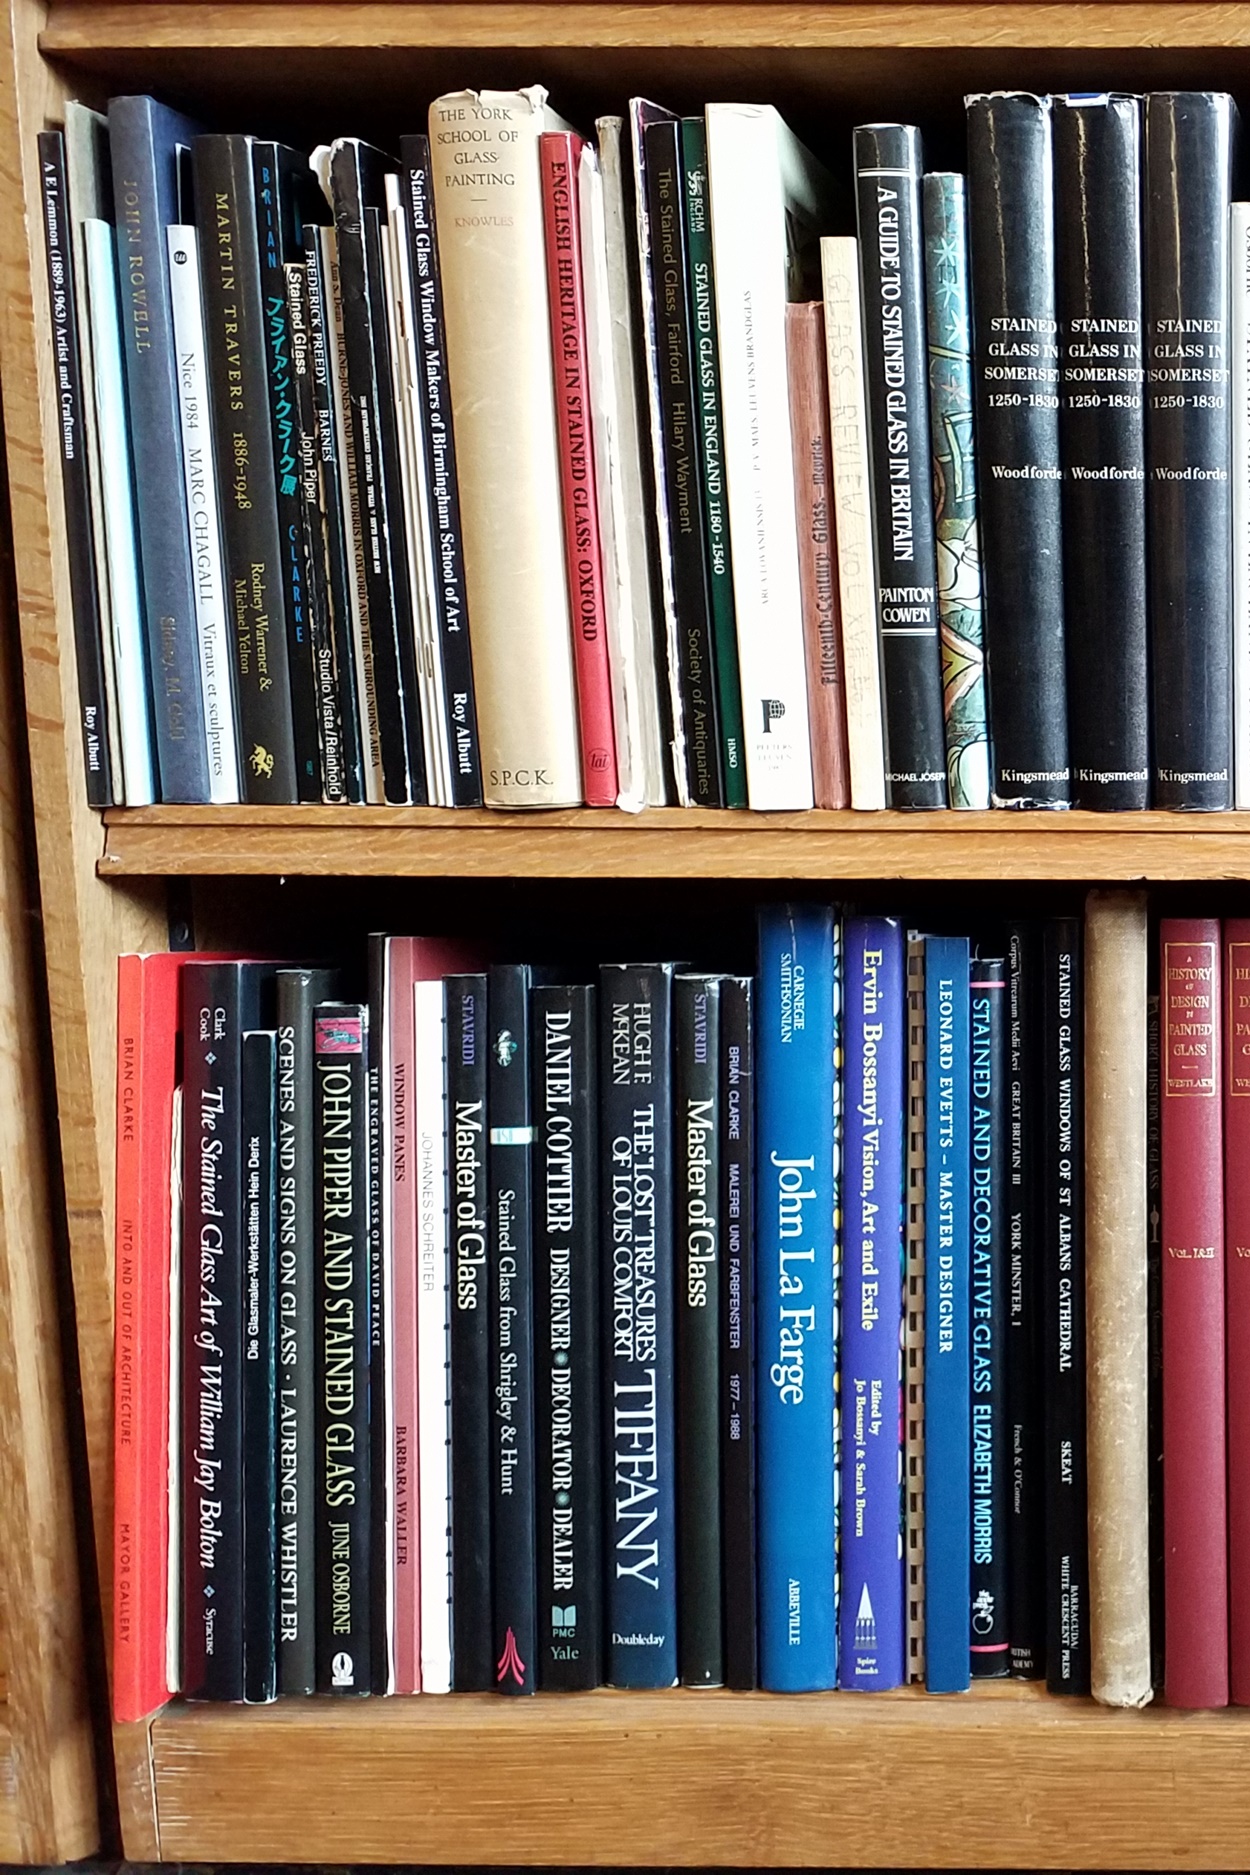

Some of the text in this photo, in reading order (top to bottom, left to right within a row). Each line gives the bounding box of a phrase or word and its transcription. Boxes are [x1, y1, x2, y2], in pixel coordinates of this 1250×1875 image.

[44, 162, 76, 459] A E Lemmon (1889-1963) Artist and Craftsman
[215, 193, 252, 509] MARTIN TRAVERS 1886-1948
[410, 169, 460, 632] Stained Glass Window Makers of Birmingham School of Art
[550, 161, 597, 641] ENGLISH HERITAGE IN STAINED GLASS: OXFORD
[695, 262, 710, 332] STAINED
[699, 337, 714, 387] GLASS
[703, 392, 716, 410] IN
[877, 187, 914, 561] A GUIDE TO STAINED GLASS IN BRITAIN
[181, 353, 224, 776] Nice 1984 MARC CHAGALL Vitraux et sculptures
[705, 415, 721, 494] ENGLAND
[879, 588, 934, 602] PAINTON
[883, 607, 930, 622] COWEN
[1001, 769, 1070, 783] Kingsmead
[781, 953, 792, 1043] SMITHSONIAN
[793, 965, 804, 1030] CARNEGIE
[939, 979, 953, 1147] LEONARD EVETTS
[545, 1010, 572, 1233] DANIEL COTTIER
[858, 949, 883, 1331] Ervin Bossanyi Vision, Art and Exile
[193, 1086, 224, 1568] The Stained Glass Art of William Jay Bolton
[278, 1027, 298, 1642] SCENES AND SIGNS ON GLASS LAURENCE WHISTLER
[317, 1061, 355, 1507] JOHN PIPER AND STAINED GLASS
[770, 1150, 816, 1404] John La Farge
[939, 1171, 953, 1353] MASTER DESIGNER
[328, 1521, 350, 1635] JUNE OSBORNE
[613, 1369, 658, 1590] TIFFANY
